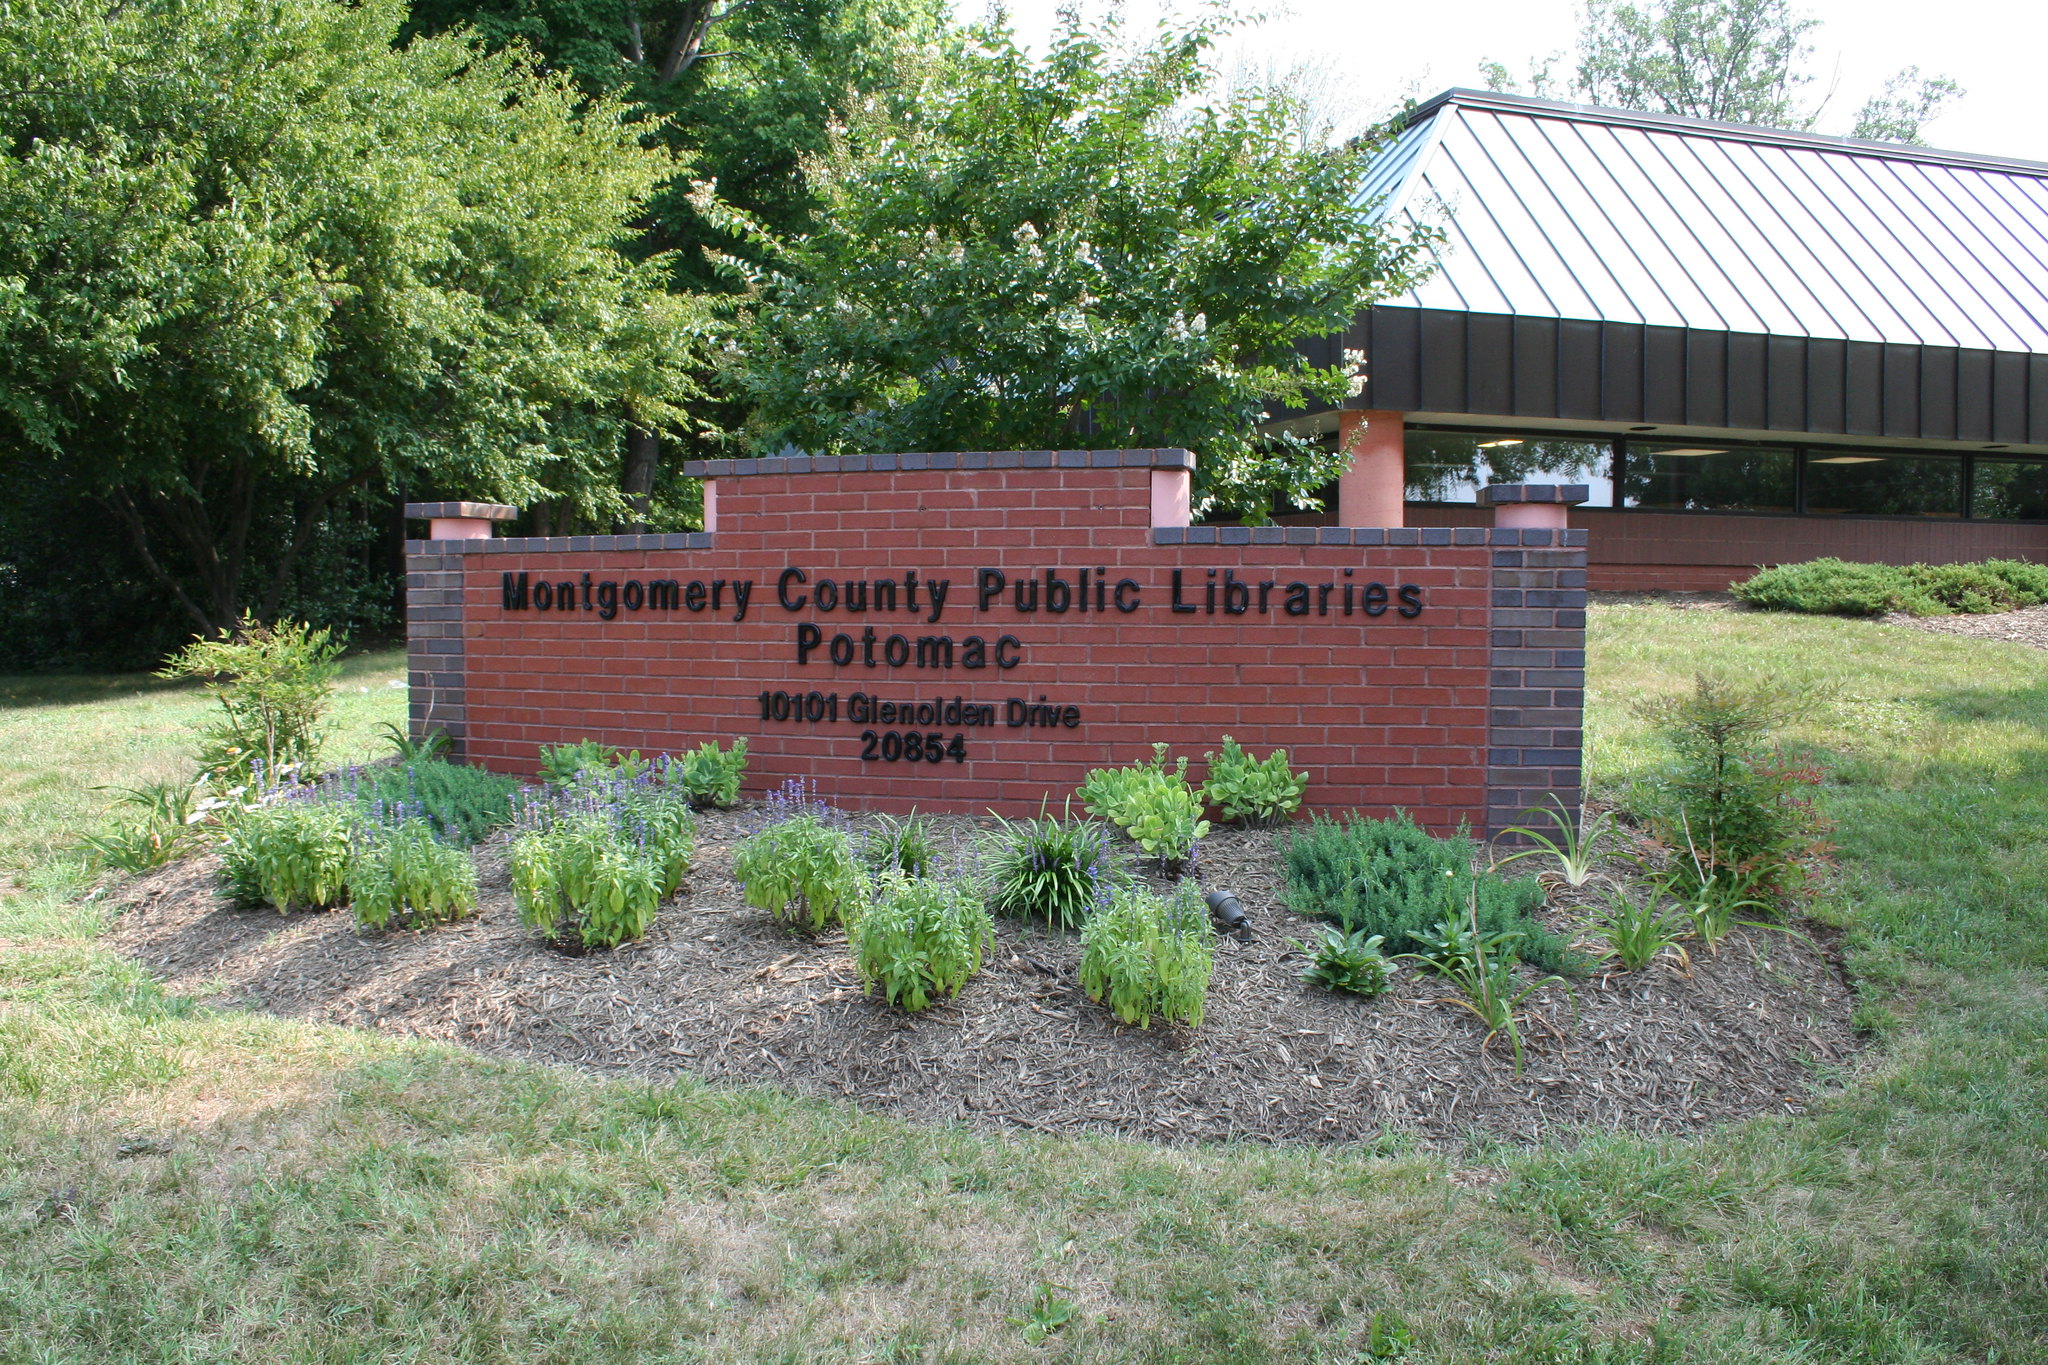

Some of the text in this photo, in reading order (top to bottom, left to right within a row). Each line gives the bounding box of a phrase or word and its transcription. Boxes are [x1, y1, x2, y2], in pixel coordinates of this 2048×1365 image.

[502, 567, 1423, 622] Montgomery County Public Libraries
[797, 623, 1021, 670] Potomac
[758, 691, 1081, 728] 10101 Glenolden Drive
[861, 730, 967, 764] 20854
